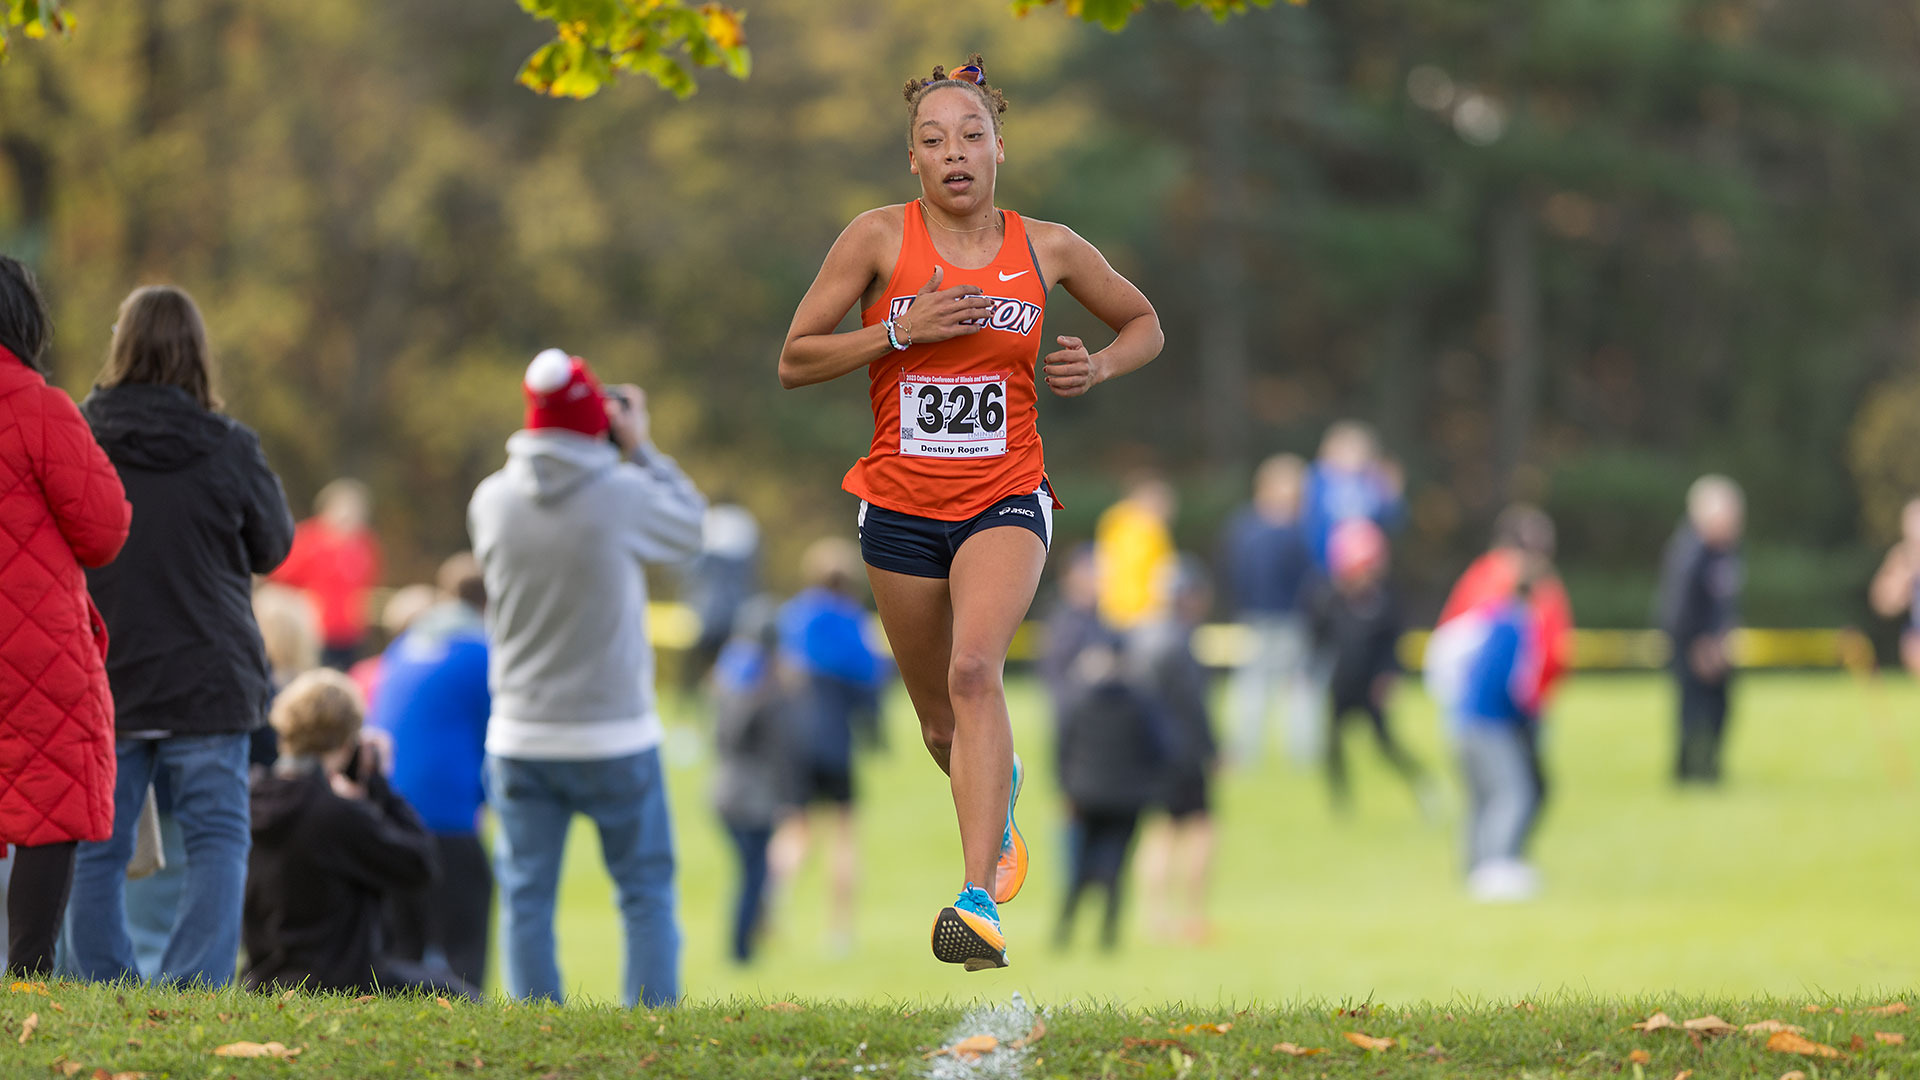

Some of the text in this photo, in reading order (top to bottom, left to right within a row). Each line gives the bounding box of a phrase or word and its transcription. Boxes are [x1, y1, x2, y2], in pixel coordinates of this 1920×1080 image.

[917, 375, 931, 383] College
[932, 375, 954, 383] Conference
[955, 375, 960, 383] of
[960, 375, 973, 383] Illinois
[982, 374, 1000, 382] Wisconsin
[917, 383, 1003, 434] 326
[921, 444, 989, 455] Destiny Rogers
